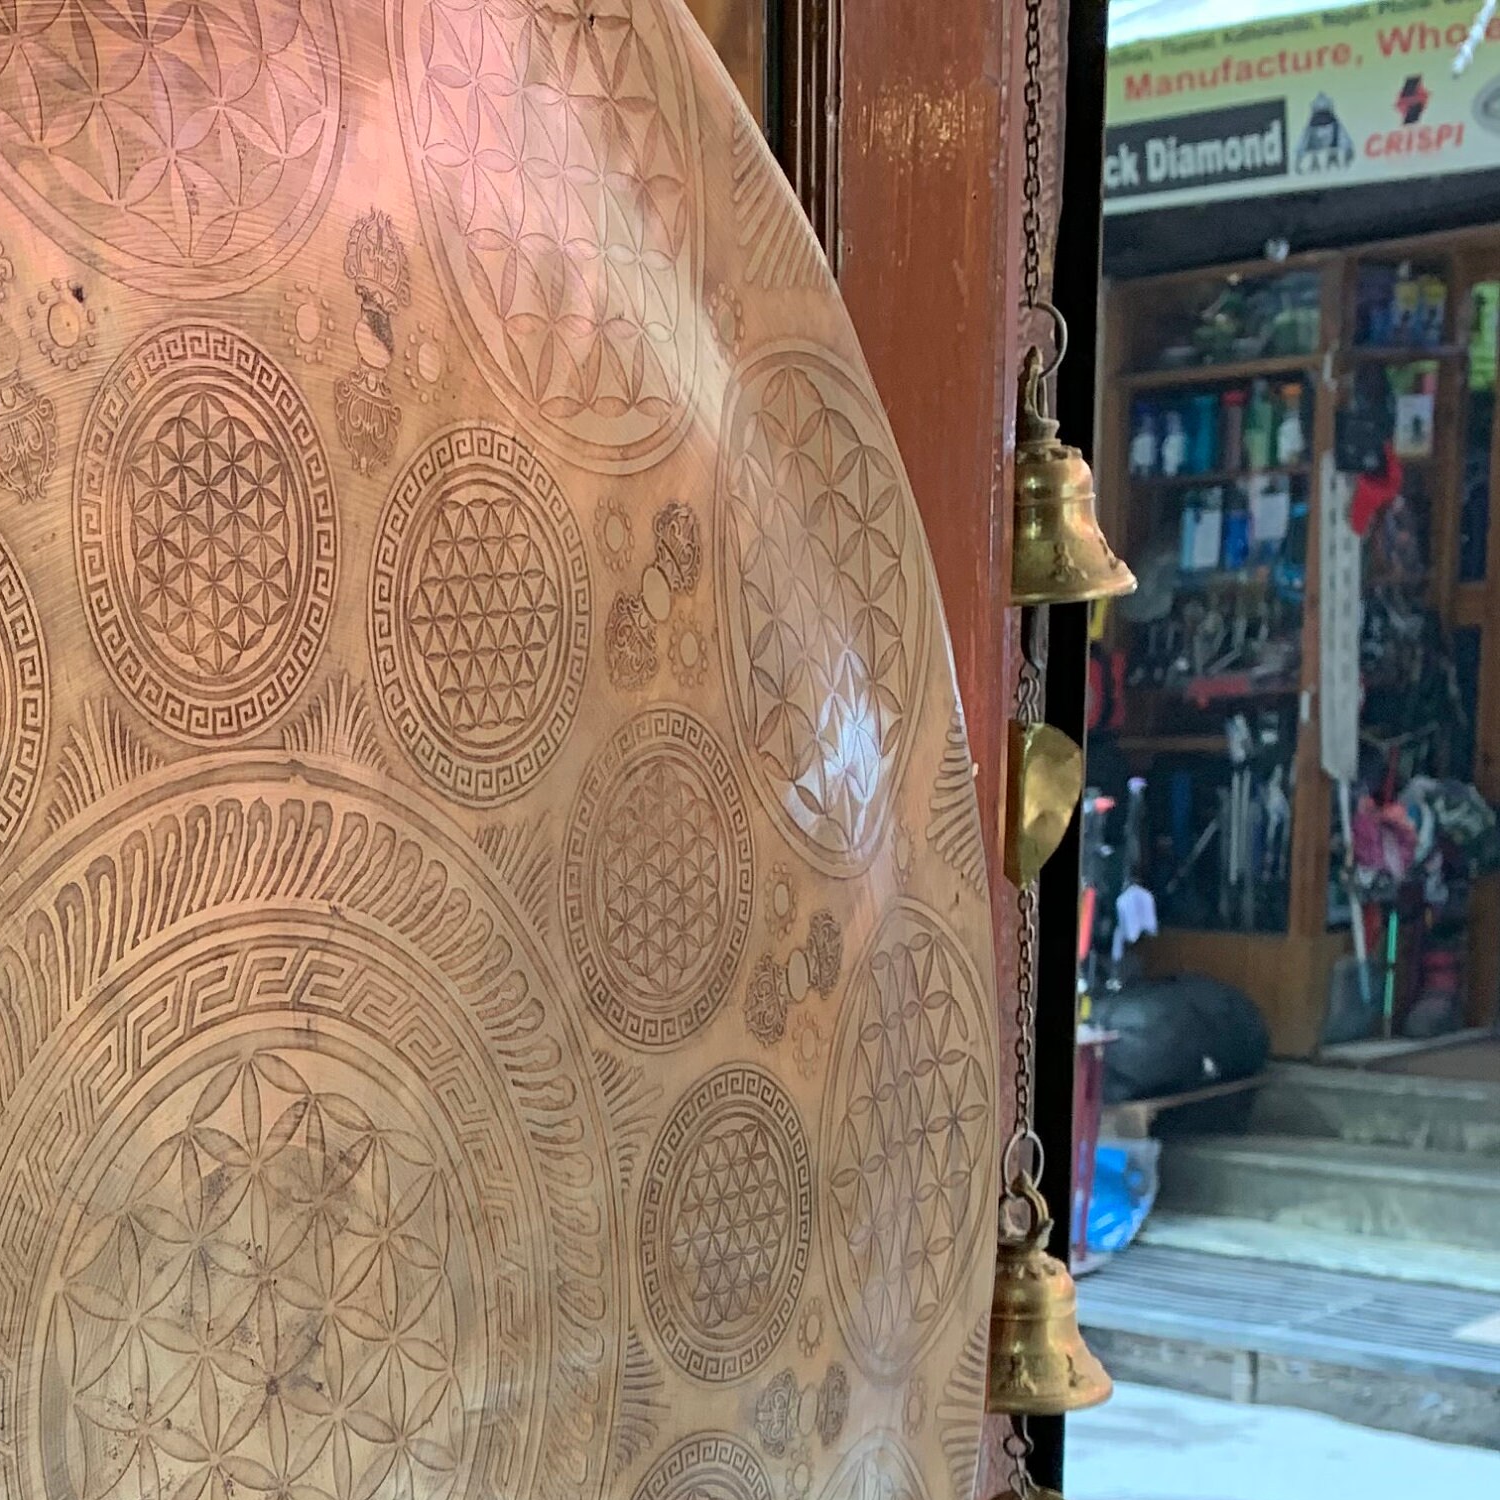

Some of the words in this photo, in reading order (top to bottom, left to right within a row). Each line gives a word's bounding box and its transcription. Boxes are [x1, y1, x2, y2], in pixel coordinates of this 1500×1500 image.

[1124, 42, 1363, 100] Manufacture,
[1145, 120, 1283, 183] Diamond
[1364, 123, 1465, 159] CRISPI
